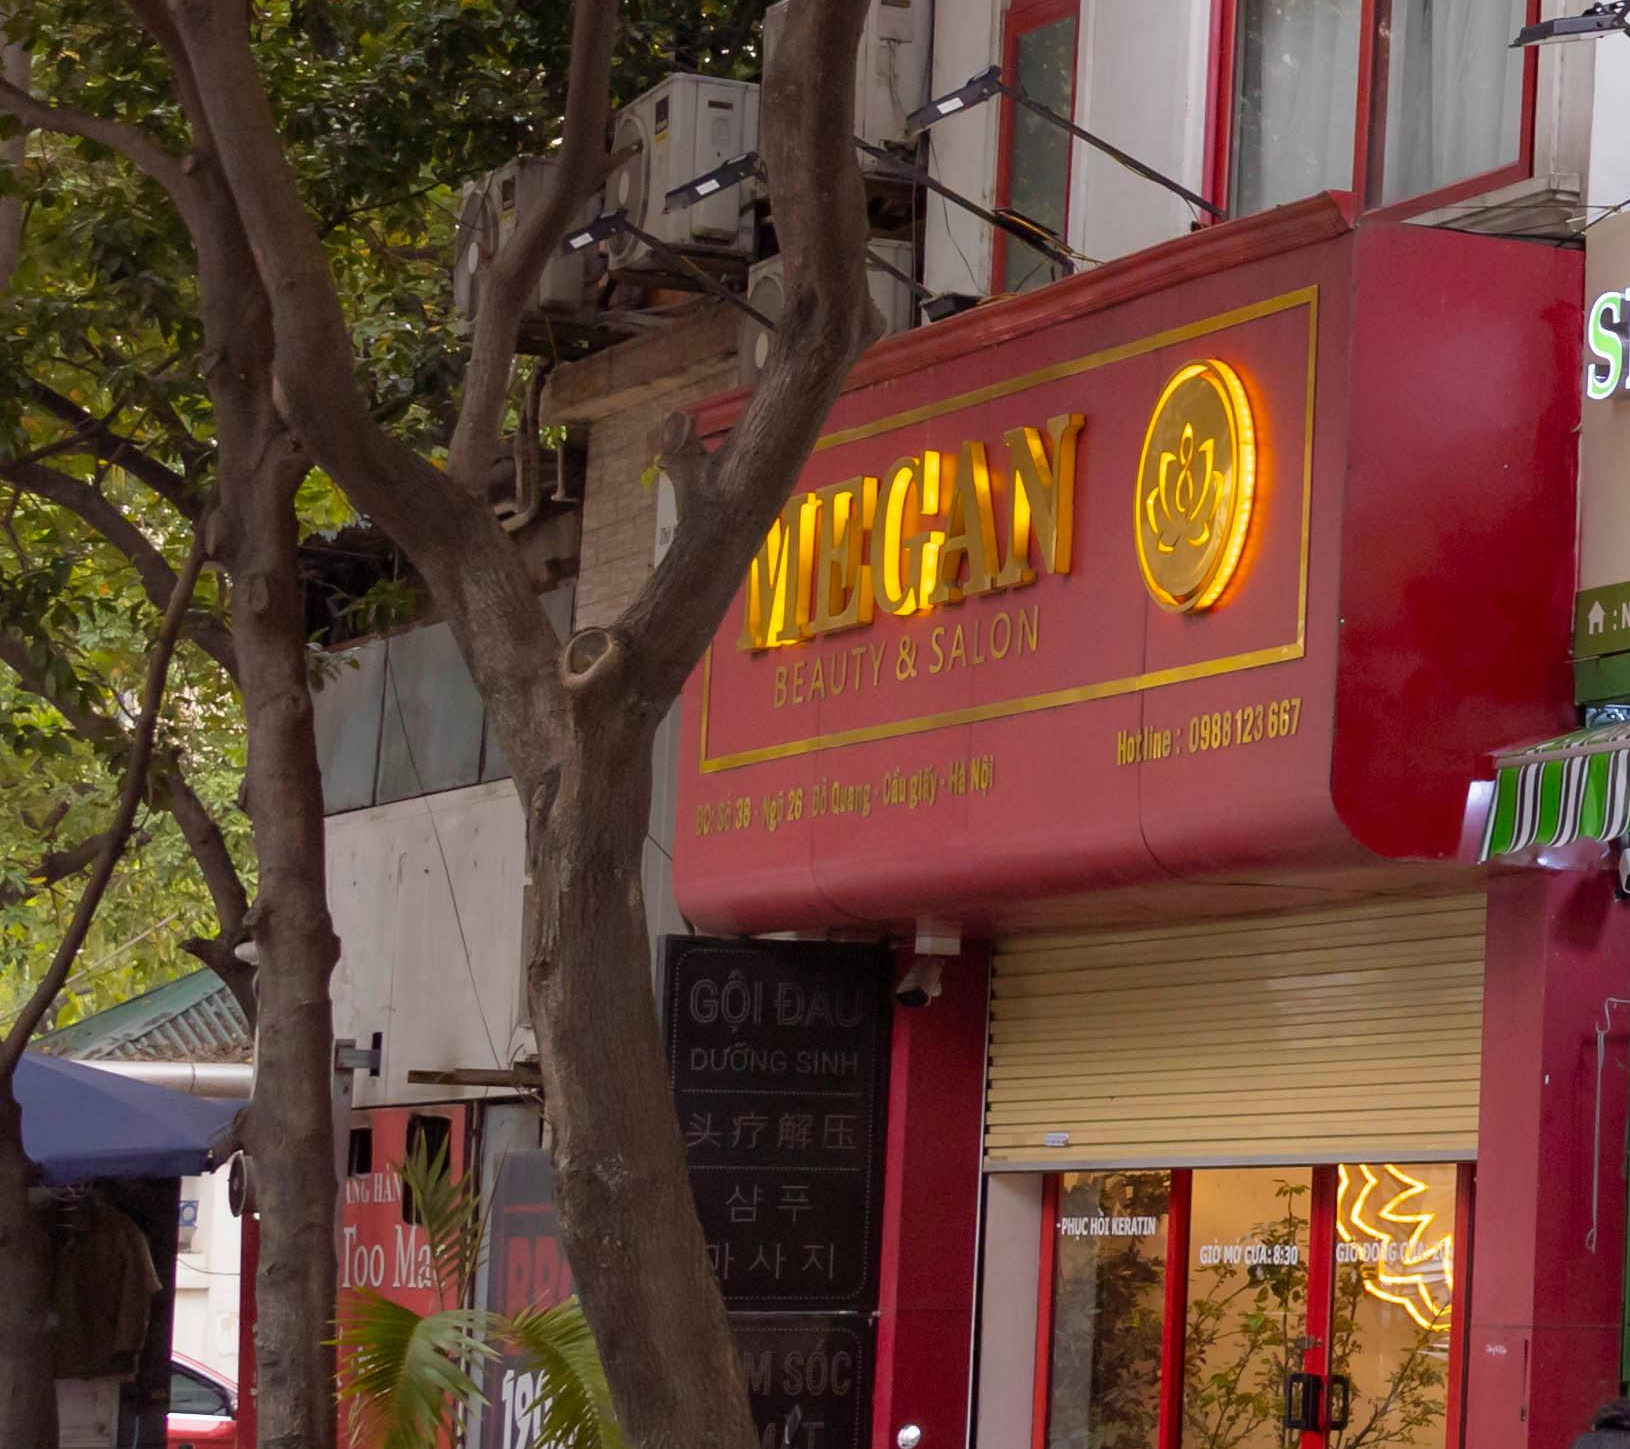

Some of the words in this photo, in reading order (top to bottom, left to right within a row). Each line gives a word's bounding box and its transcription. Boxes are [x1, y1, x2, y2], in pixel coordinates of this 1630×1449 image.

[736, 412, 1085, 653] MEGAN
[773, 639, 888, 710] BEAUTY
[895, 635, 918, 681] &
[928, 604, 1040, 675] SALON
[1188, 710, 1233, 753] 0988
[1267, 697, 1302, 739] 667
[787, 787, 803, 821] 26
[831, 780, 871, 817] Quang
[1111, 1216, 1156, 1236] KERATIN
